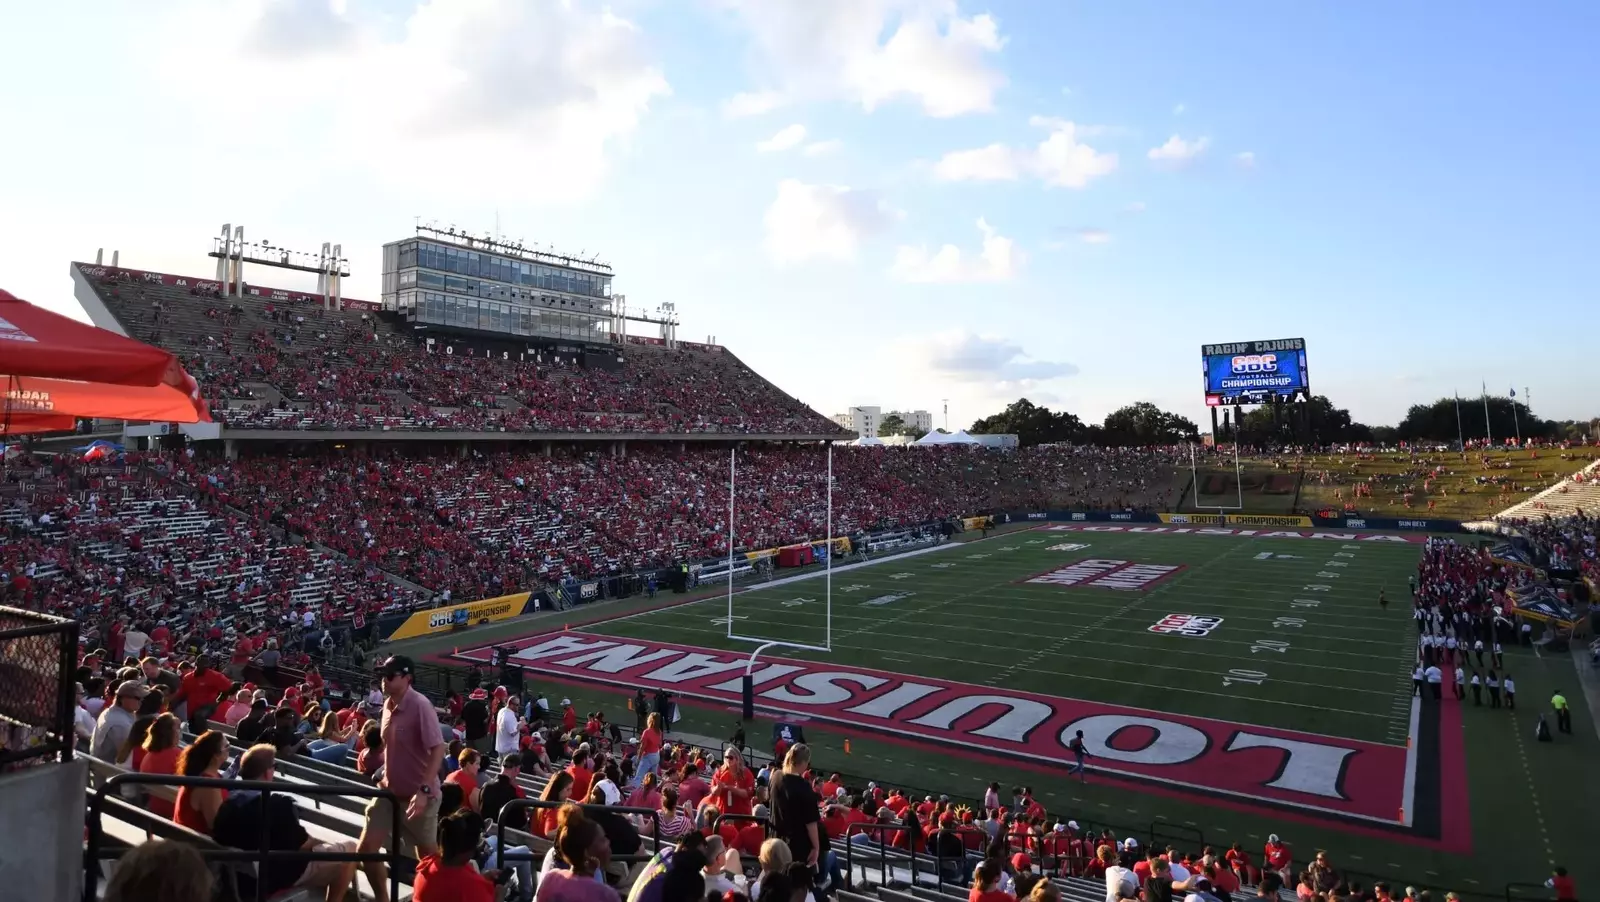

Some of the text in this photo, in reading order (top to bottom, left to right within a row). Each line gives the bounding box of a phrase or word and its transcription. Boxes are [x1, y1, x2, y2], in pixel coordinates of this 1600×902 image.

[1206, 340, 1302, 355] RAGIN' CAJUNS
[1232, 354, 1277, 373] SBC
[1222, 378, 1292, 388] CHAMPIONSHIP
[1236, 516, 1300, 526] CHAMPIONSHIP
[1250, 640, 1290, 652] 20
[1223, 668, 1268, 686] 10
[509, 635, 1357, 800] LOUISIANA
